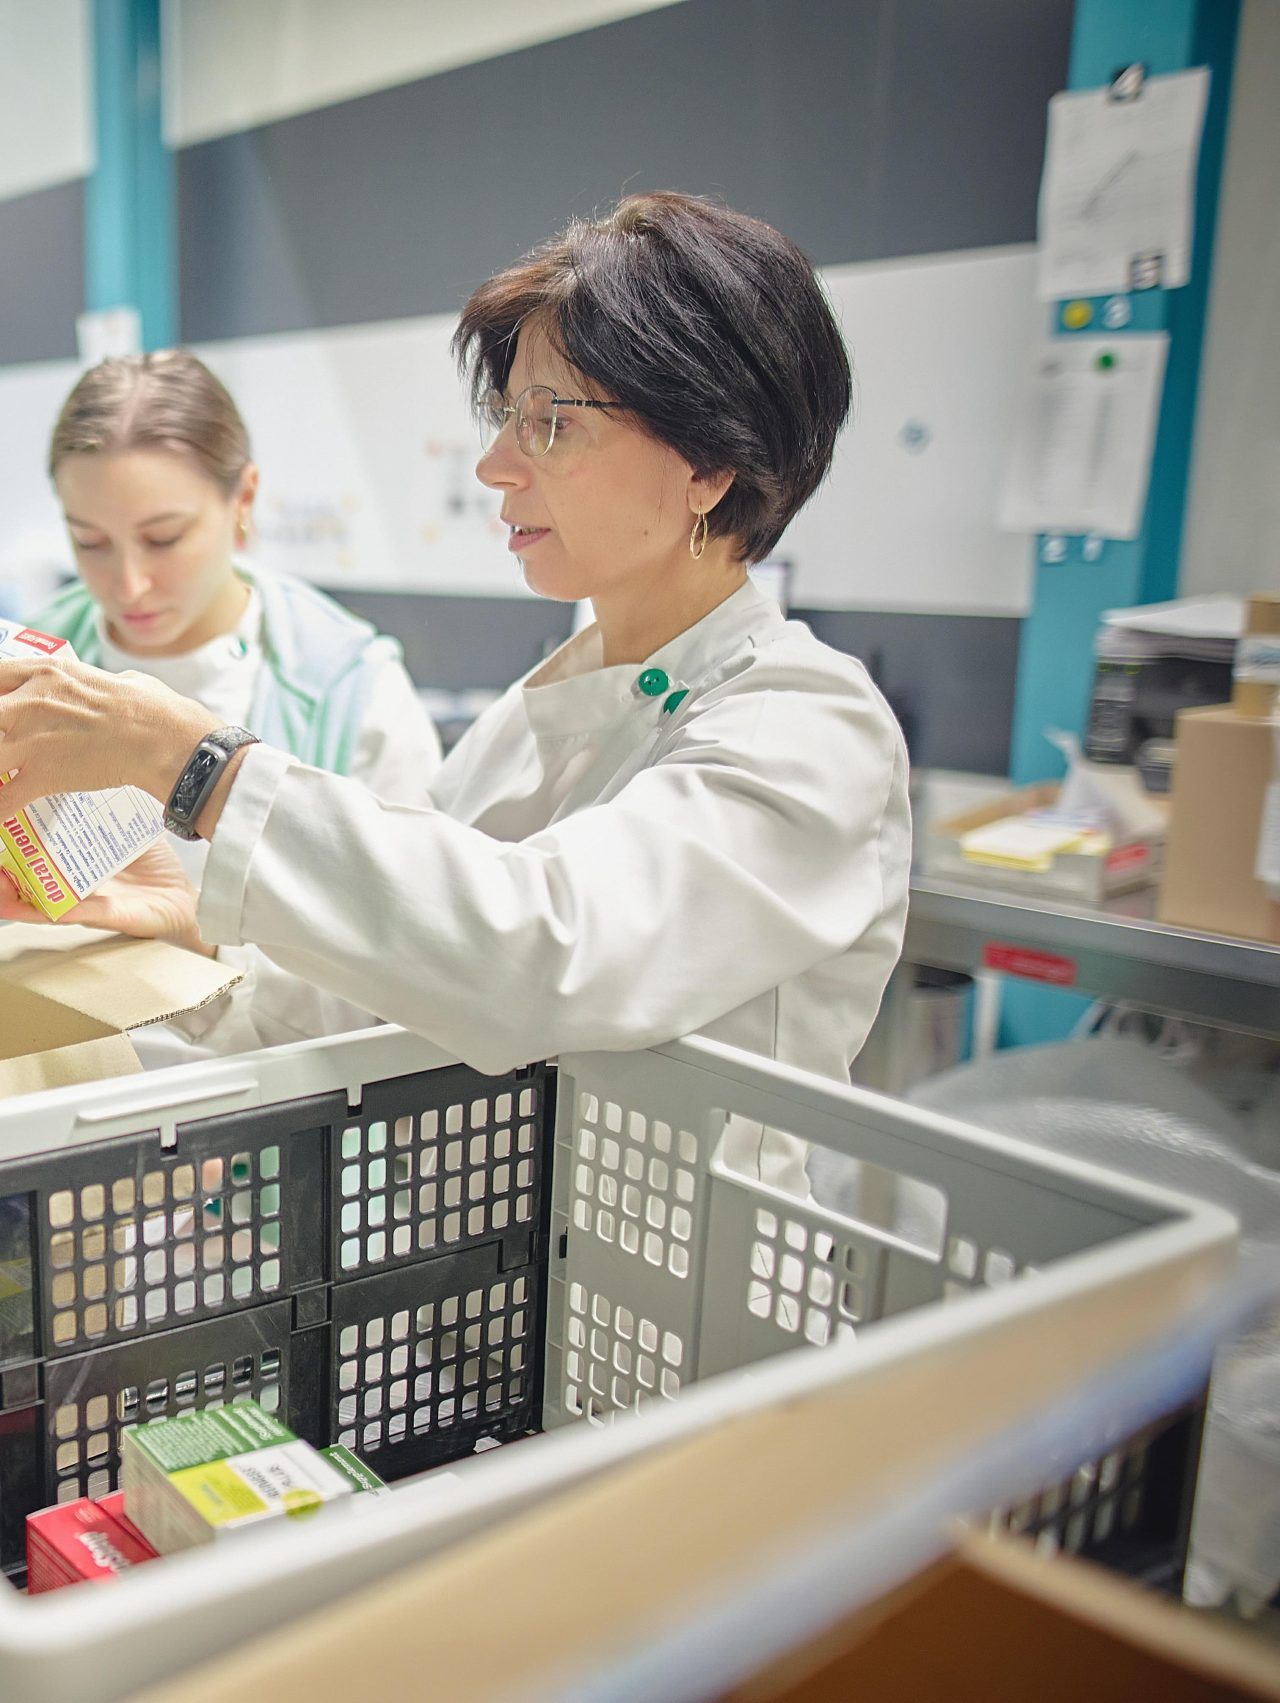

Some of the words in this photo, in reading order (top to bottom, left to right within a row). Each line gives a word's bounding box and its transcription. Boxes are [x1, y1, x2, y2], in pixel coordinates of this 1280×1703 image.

[2, 817, 36, 857] pent
[59, 852, 72, 871] Vitamina
[29, 855, 65, 903] dozaj
[73, 875, 85, 891] CaMgZn
